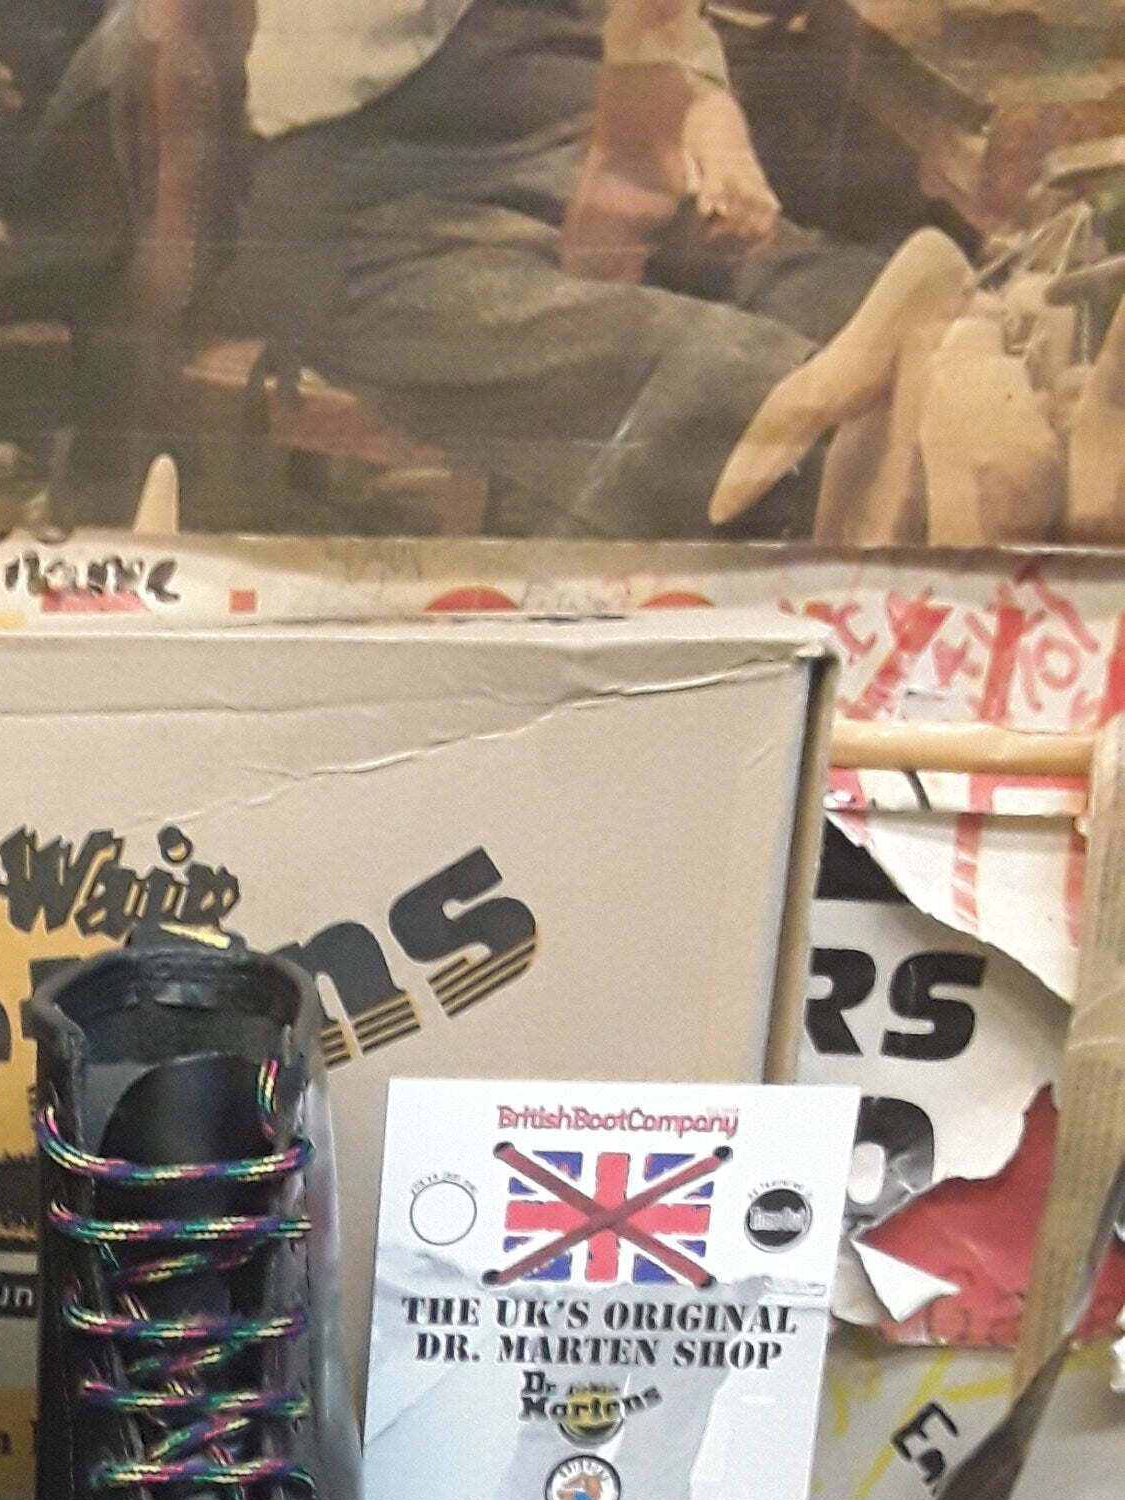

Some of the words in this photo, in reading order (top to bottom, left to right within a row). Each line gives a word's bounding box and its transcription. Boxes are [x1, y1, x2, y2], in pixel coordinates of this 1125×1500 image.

[497, 1103, 739, 1140] BritishBootCompany
[402, 1297, 481, 1327] THE
[495, 1299, 590, 1330] UK'S
[603, 1303, 797, 1335] ORIGINAL
[415, 1331, 481, 1363] DR.
[497, 1334, 659, 1368] MARTEN
[673, 1339, 783, 1371] SHOP
